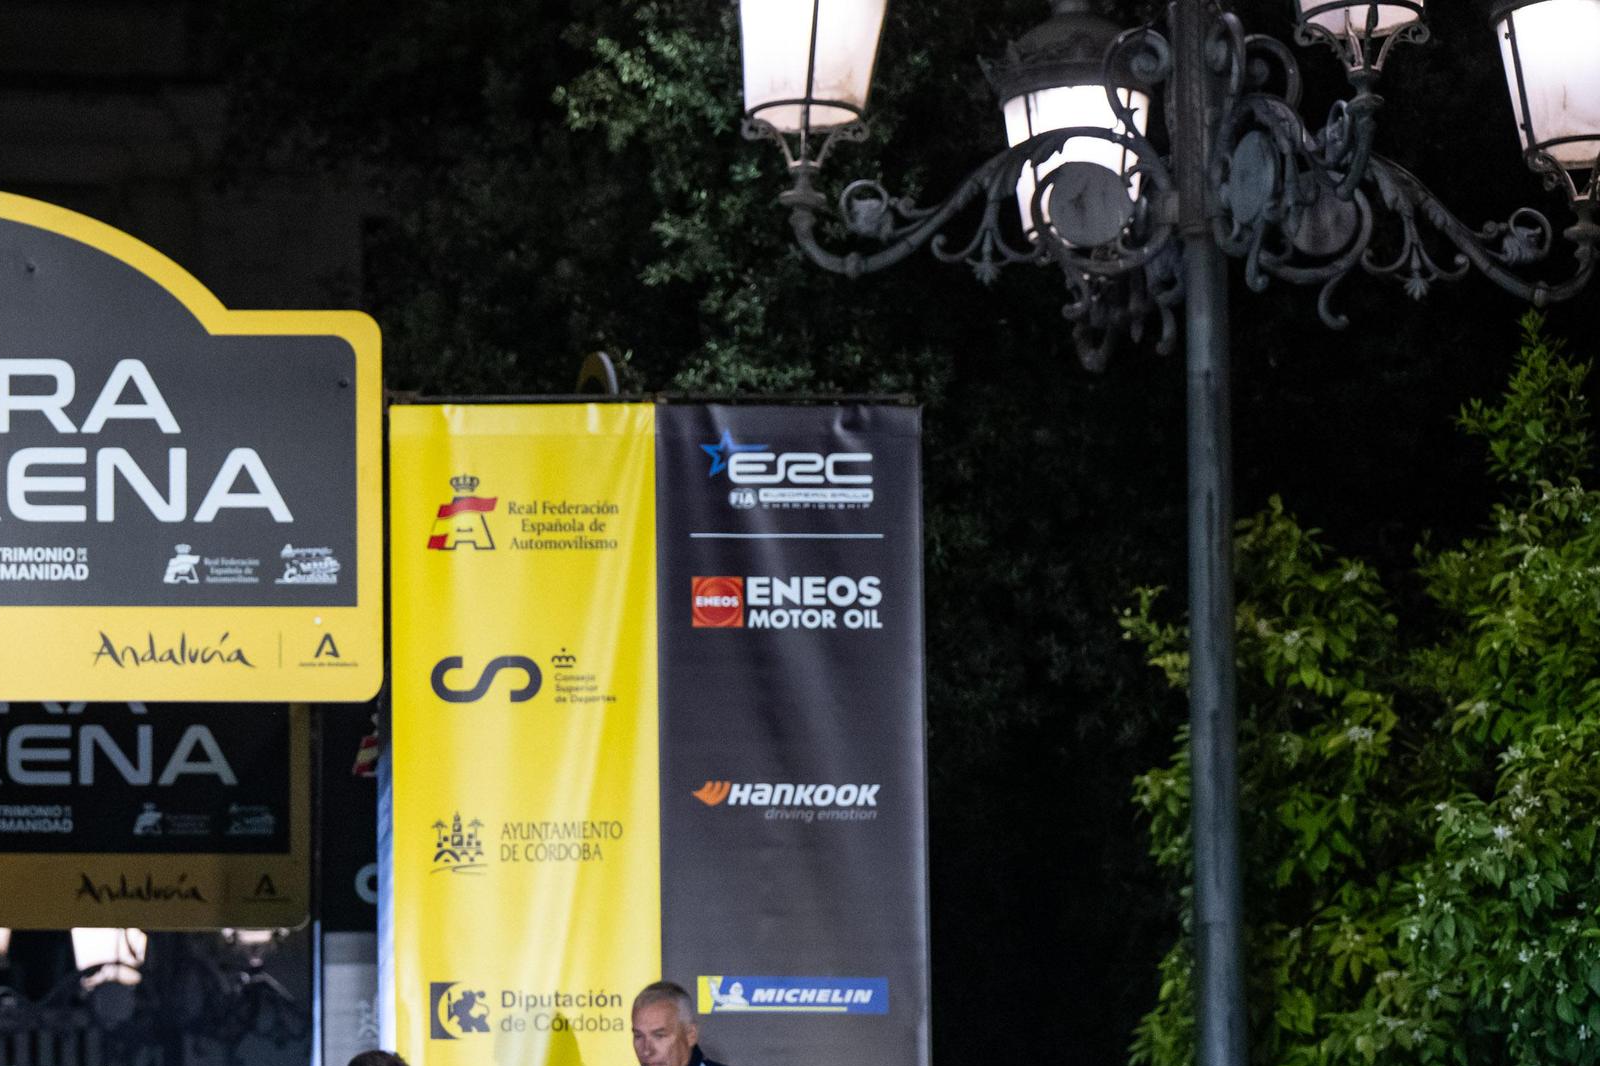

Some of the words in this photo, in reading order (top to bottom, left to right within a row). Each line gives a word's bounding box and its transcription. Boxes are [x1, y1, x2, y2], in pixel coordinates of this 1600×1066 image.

[507, 501, 538, 517] Real
[542, 500, 620, 517] Federación
[520, 519, 587, 536] Española
[589, 518, 606, 533] de
[509, 536, 619, 551] Automovilismo
[746, 575, 883, 607] ENEOS
[695, 595, 740, 608] ENEOS
[747, 608, 837, 630] MOTOR
[843, 608, 883, 630] OIL
[93, 631, 257, 668] Andalucía
[764, 808, 815, 824] driving
[817, 808, 878, 822] emotion
[500, 820, 623, 843] AYUNTAMIENTO
[500, 843, 521, 863] DE
[500, 989, 623, 1012] Diputación
[751, 988, 874, 1005] MICHELIN
[500, 1013, 526, 1033] de
[534, 1012, 625, 1033] Córdoba
